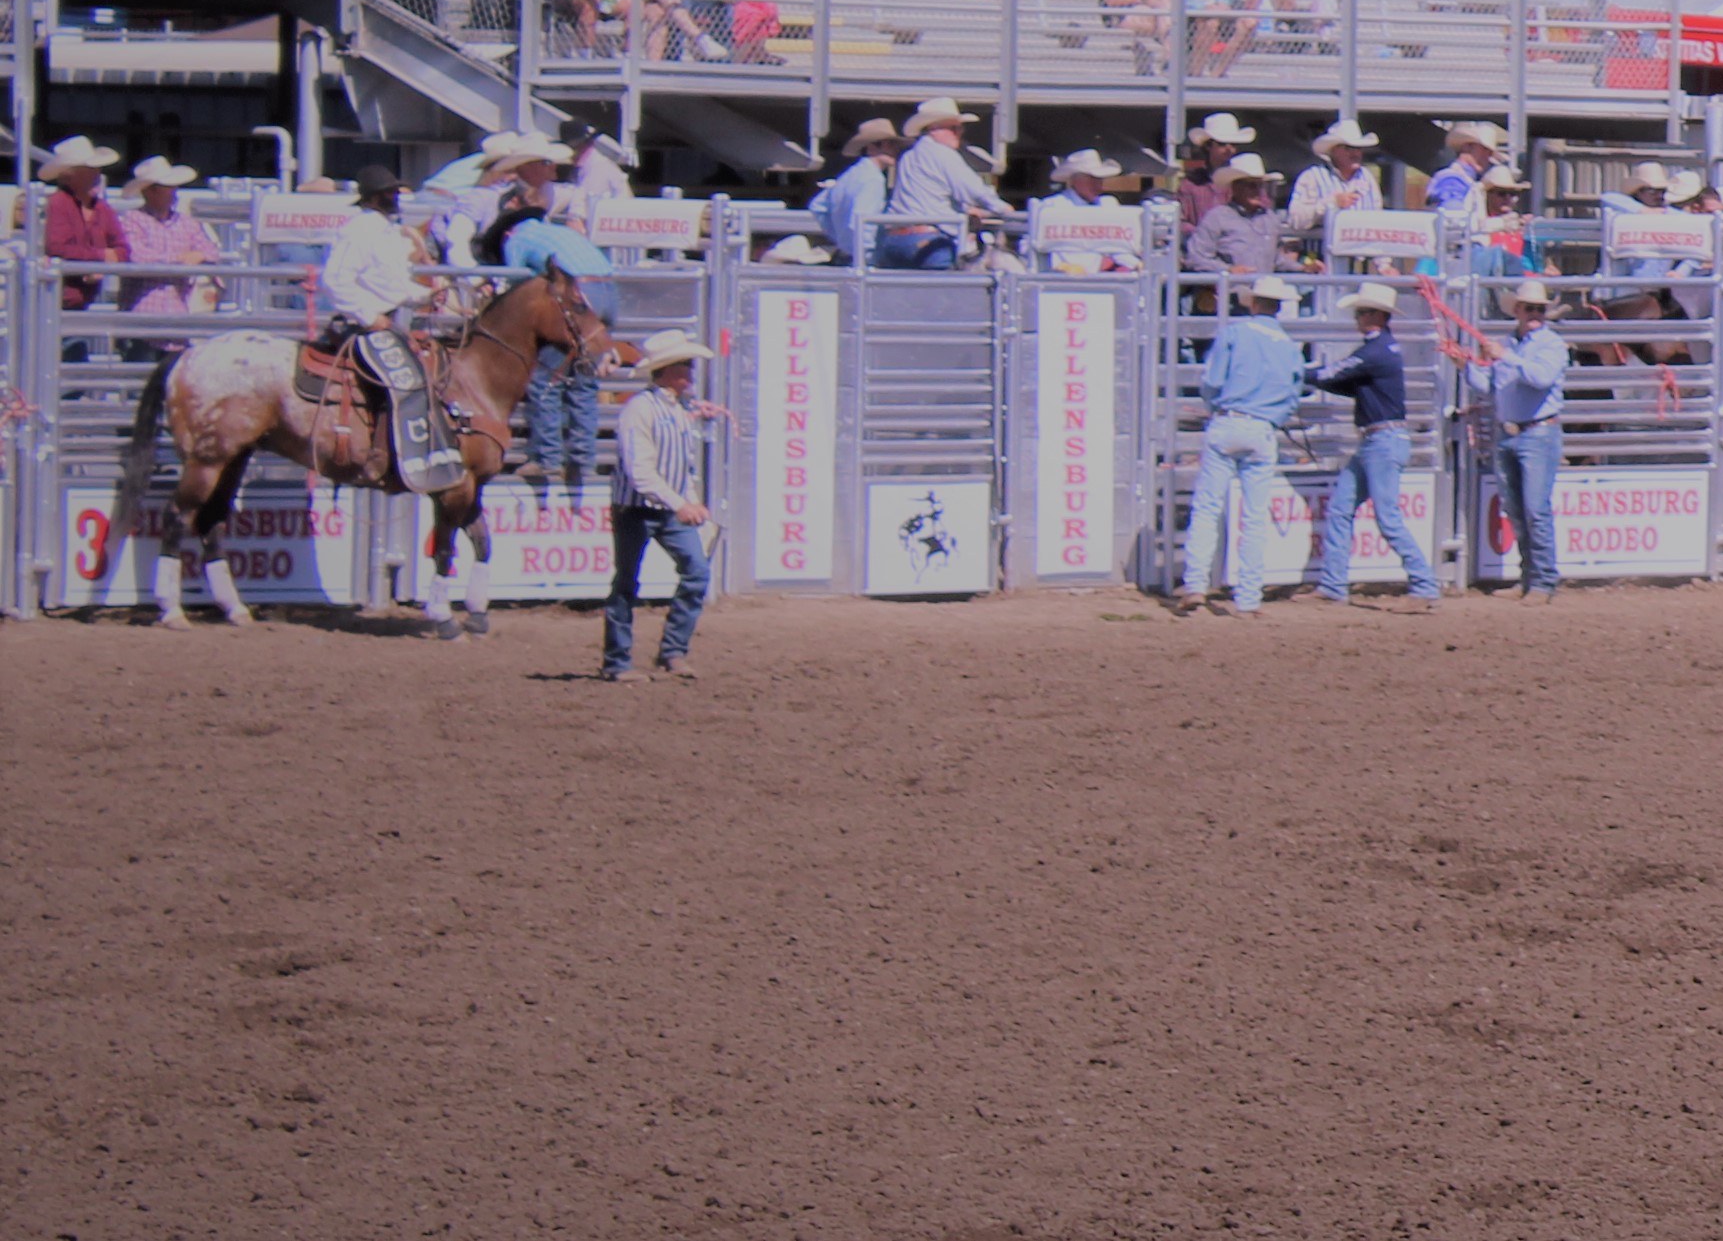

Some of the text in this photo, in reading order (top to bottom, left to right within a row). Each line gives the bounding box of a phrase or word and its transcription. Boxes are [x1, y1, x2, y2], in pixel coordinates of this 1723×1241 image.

[600, 217, 689, 234] ELLENSBURG
[1045, 225, 1134, 241] ELLENSBURG
[1341, 227, 1428, 246] ELLENSBURG
[1618, 231, 1704, 247] ELLENSBURG
[781, 299, 809, 571] ELLENSBURG
[1062, 301, 1087, 566] ELLENSBURG
[76, 508, 110, 580] 3
[1567, 527, 1658, 552] RODEO
